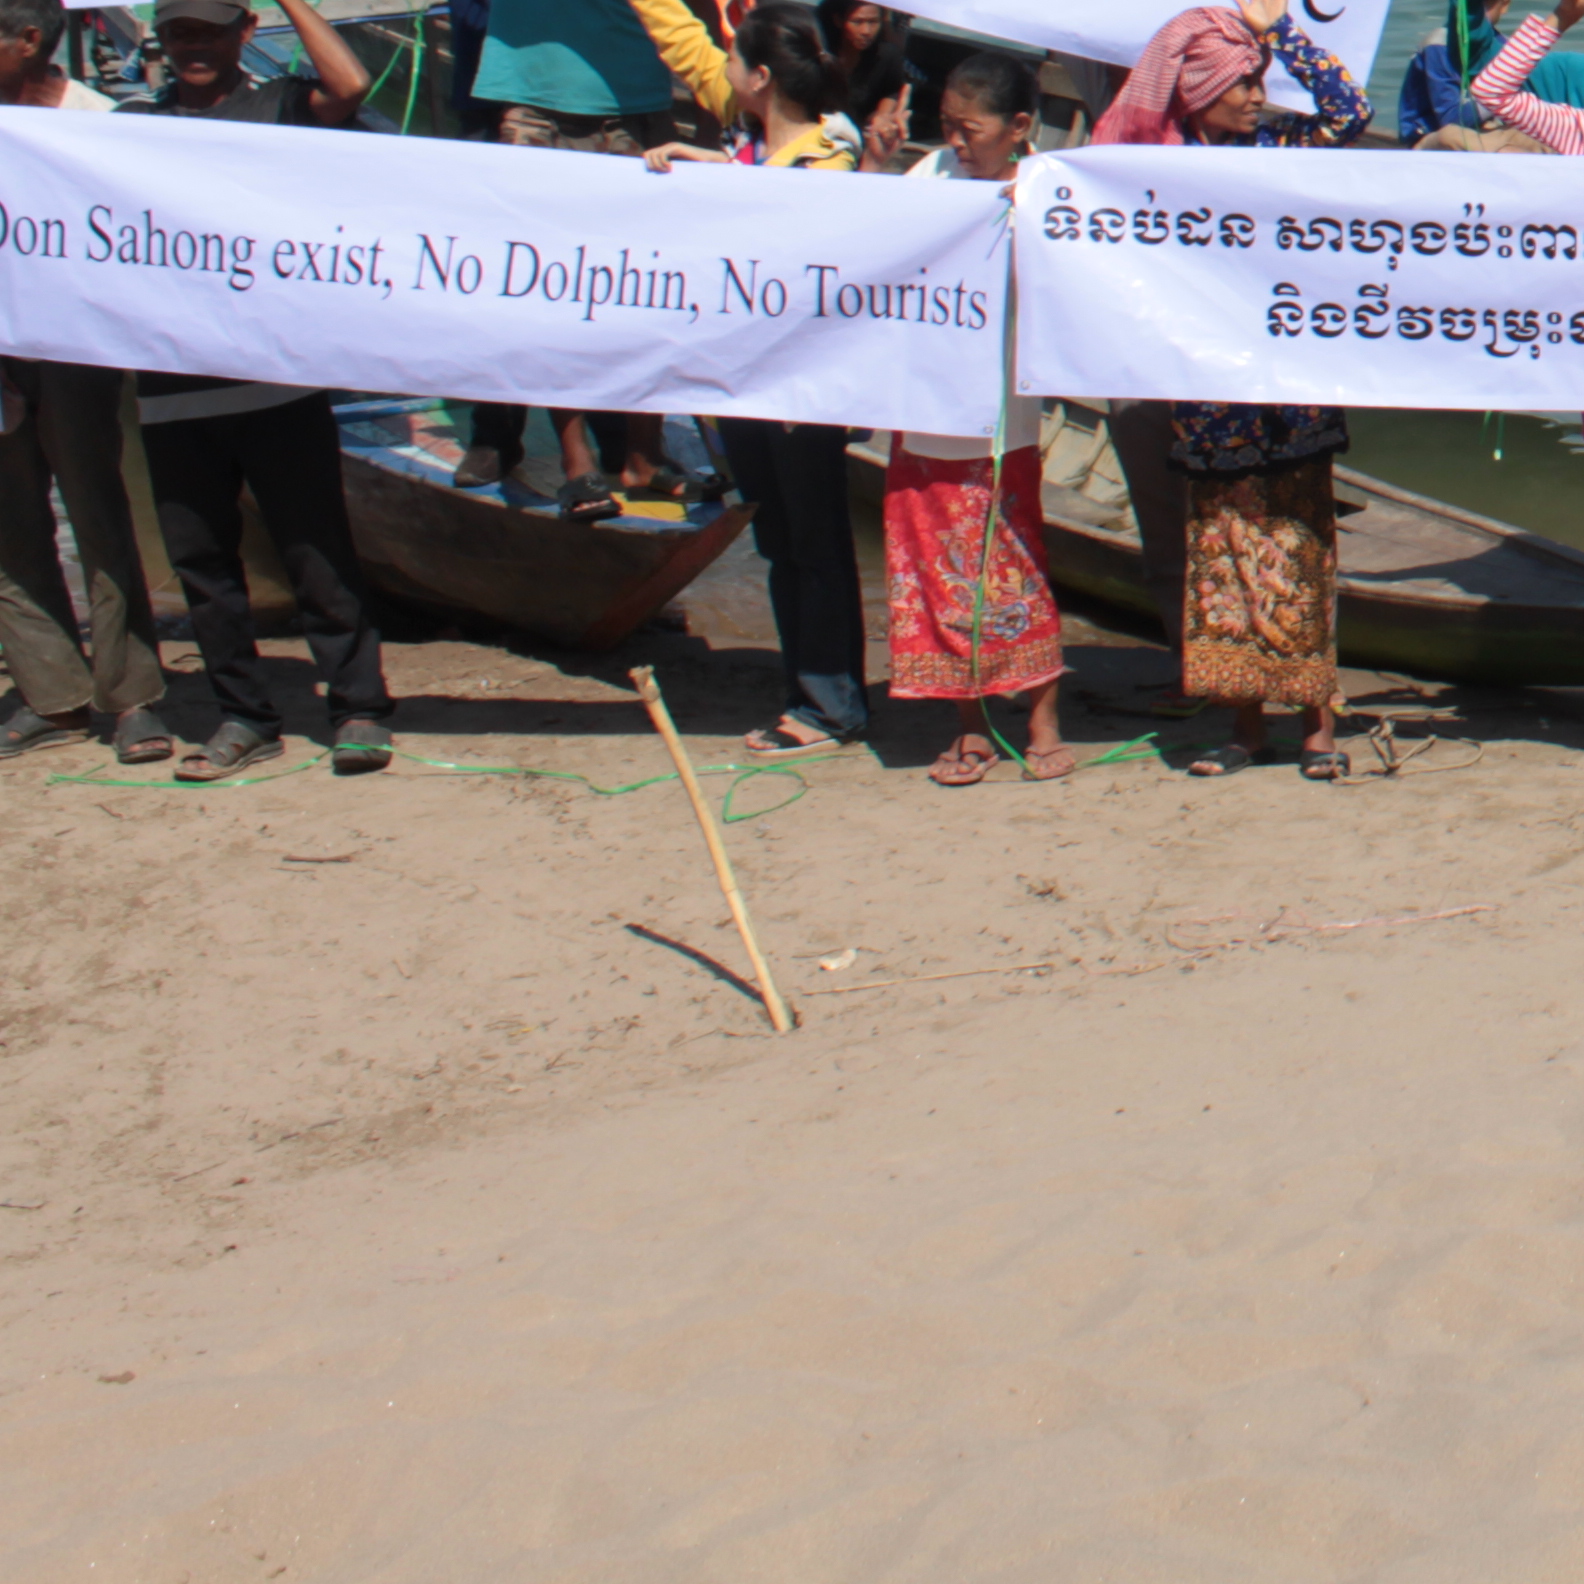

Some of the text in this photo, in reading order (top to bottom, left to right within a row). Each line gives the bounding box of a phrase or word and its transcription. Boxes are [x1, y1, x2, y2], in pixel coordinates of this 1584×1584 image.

[0, 202, 986, 330] on Sahong exist, No Dolphin, No Tourists
